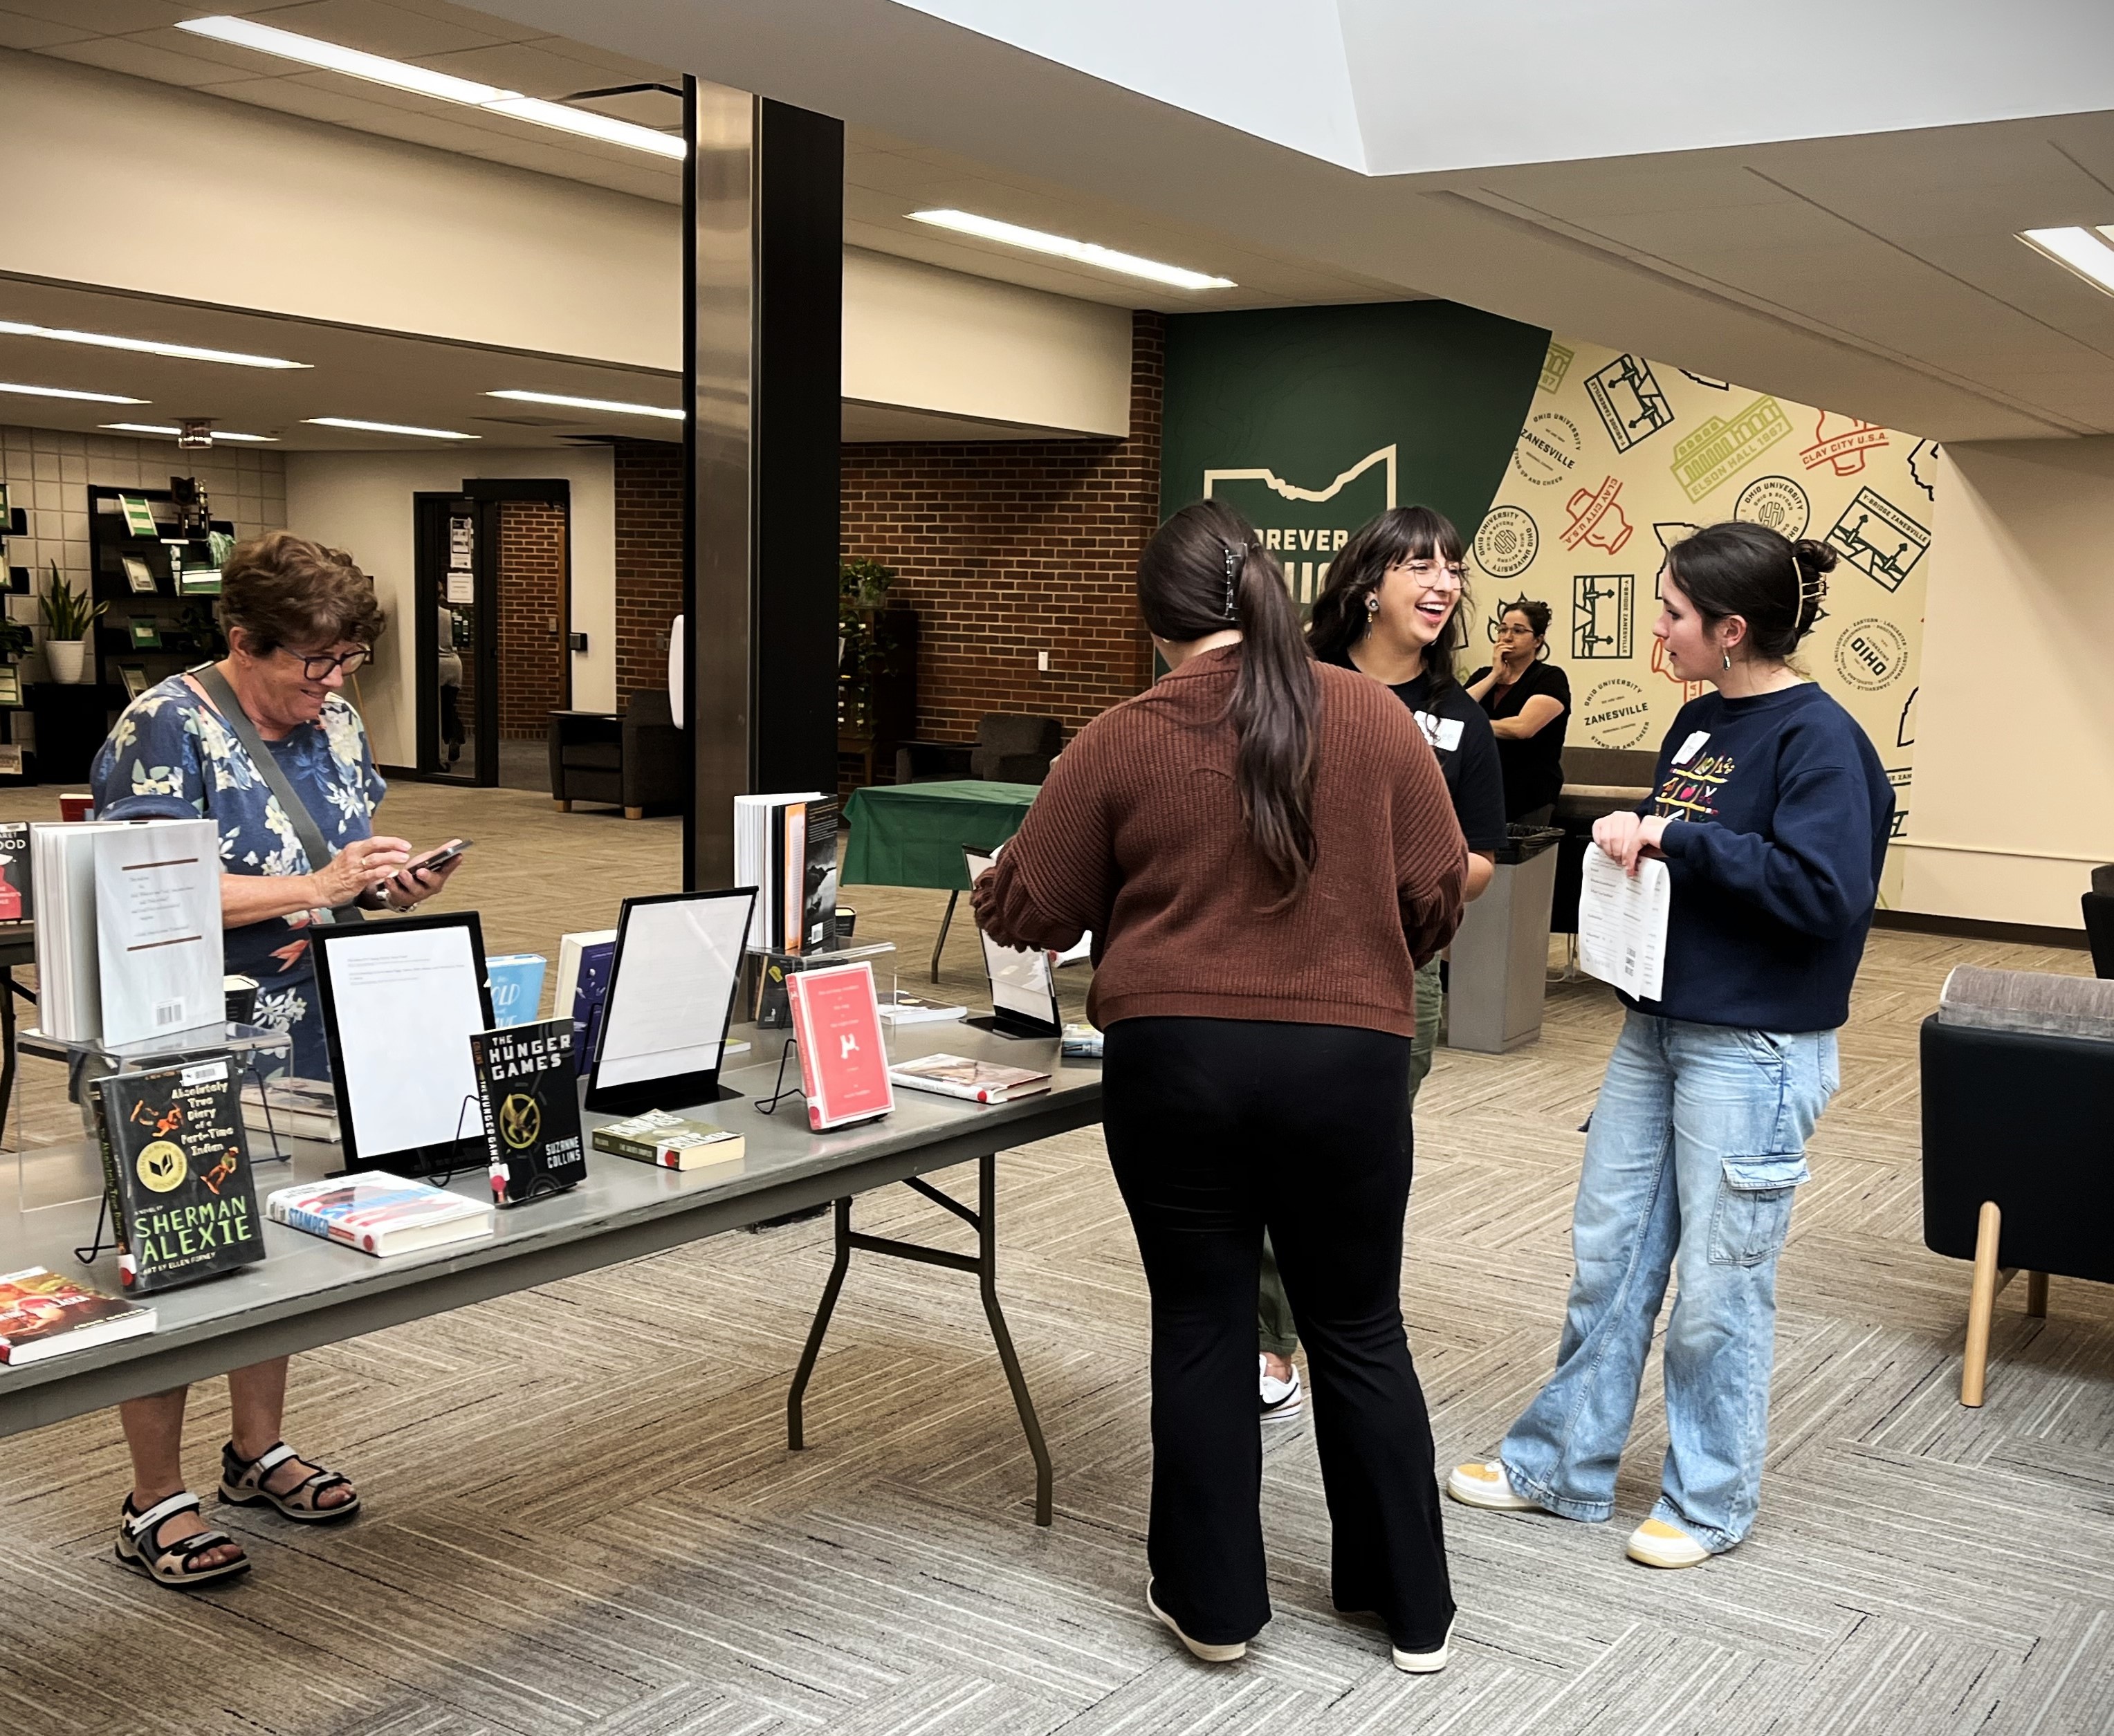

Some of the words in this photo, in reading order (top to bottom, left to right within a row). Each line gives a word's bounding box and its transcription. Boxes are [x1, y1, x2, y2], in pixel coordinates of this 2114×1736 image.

[1542, 375, 1555, 387] 67
[1533, 413, 1552, 423] OHIO
[1554, 414, 1581, 451] UNIVERSITY
[1520, 428, 1576, 470] ZANESVILLE
[1693, 467, 1727, 496] ELSON
[1728, 448, 1756, 472] HALL
[1756, 425, 1785, 445] 1967
[1802, 447, 1828, 465] CLAY
[1830, 439, 1854, 452] CITY
[1857, 432, 1888, 445] U.S.A.
[1601, 478, 1618, 503] CLAY
[1745, 486, 1762, 504] OHIO
[1764, 482, 1803, 510] UNIVERSITY
[1480, 512, 1519, 535] UNIVERSITY
[1586, 503, 1603, 524] CITY
[1863, 493, 1891, 517] Y-BRIDGE
[1891, 513, 1928, 542] ZANESVILLE
[1253, 528, 1348, 551] OREVER
[1492, 549, 1532, 572] UNIVERSITY
[1851, 637, 1886, 676] OHIO
[1584, 688, 1597, 707] OHIO
[1598, 678, 1643, 694] UNIVERSITY
[1584, 702, 1648, 726] ZANESVILLE
[1622, 741, 1635, 750] AND
[1636, 721, 1651, 743] CHEER
[488, 1034, 571, 1064] HUNGER
[492, 1034, 513, 1046] THE
[491, 1053, 562, 1081] GAMES
[172, 1081, 228, 1100] Absolutely
[479, 1080, 488, 1094] THE
[187, 1097, 214, 1108] True
[187, 1108, 217, 1121] Diary
[195, 1120, 205, 1129] of
[481, 1094, 496, 1136] HUNGER
[181, 1127, 234, 1145] Part-Time
[545, 1136, 580, 1156] SUZANNE
[190, 1143, 224, 1156] Indian
[546, 1149, 581, 1169] COLLINS
[103, 1142, 115, 1189] Absolutely
[109, 1188, 120, 1210] True
[114, 1210, 124, 1237] Diary
[134, 1195, 247, 1238] SHERMAN
[141, 1215, 252, 1266] ALEXIE
[143, 1266, 158, 1275] ART
[158, 1264, 167, 1272] BY
[168, 1258, 190, 1269] ELLEN
[190, 1251, 217, 1263] FORNEY
